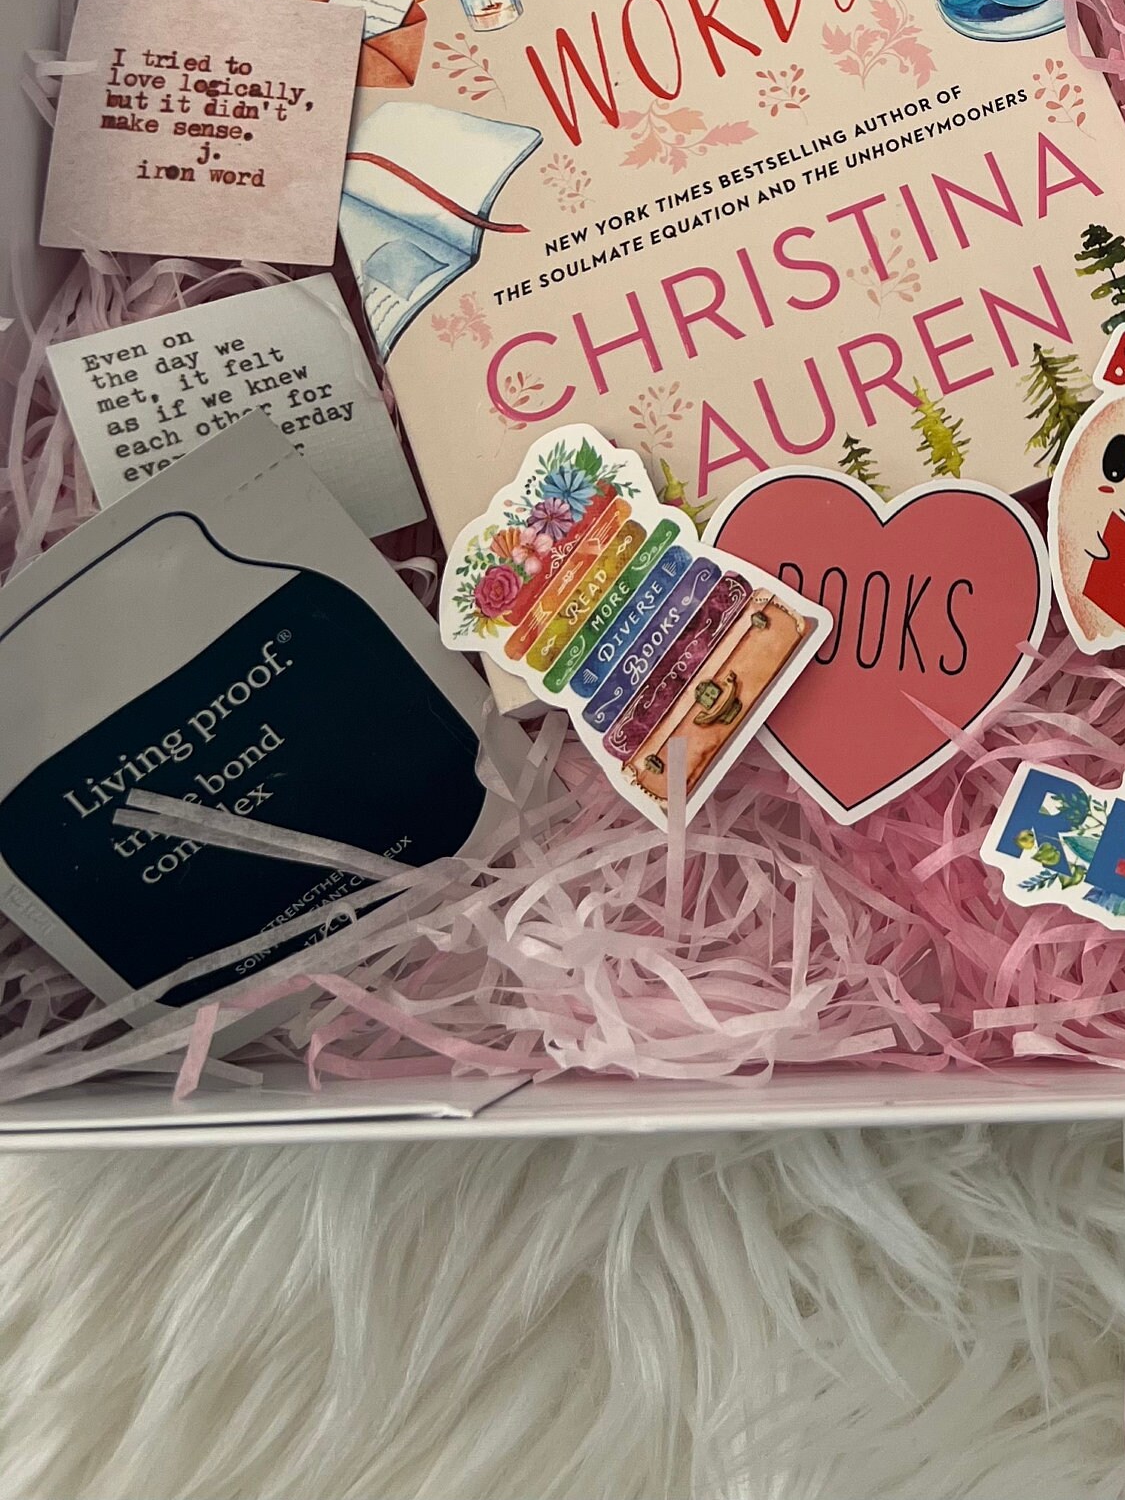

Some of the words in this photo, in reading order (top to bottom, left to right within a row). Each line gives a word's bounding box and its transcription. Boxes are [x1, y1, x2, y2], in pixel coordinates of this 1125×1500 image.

[107, 67, 166, 90] love
[179, 73, 314, 113] logically,
[112, 48, 126, 67] I
[142, 49, 211, 73] tried
[225, 59, 252, 75] to
[100, 114, 159, 134] make
[173, 122, 254, 142] sense.
[105, 90, 149, 110] but
[160, 93, 191, 113] it
[204, 99, 288, 122] didn't
[136, 160, 196, 182] iron
[209, 169, 265, 188] word
[197, 141, 220, 165] j.
[545, 227, 588, 257] NEW
[596, 204, 650, 236] YORK
[655, 180, 713, 213] TIMES
[718, 129, 848, 190] BESTSELLING
[854, 98, 932, 138] AUTHOR
[936, 85, 962, 105] OF
[494, 279, 533, 305] THE
[539, 235, 644, 288] SOULMATE
[650, 195, 750, 245] EQUATION
[757, 178, 797, 205] AND
[802, 160, 840, 185] THE
[845, 89, 1028, 169] UNHONEYMOONERS
[486, 131, 1105, 422] CHRISTINA
[81, 343, 149, 373] Even
[163, 331, 195, 349] on
[91, 369, 140, 390] the
[155, 351, 200, 375] day
[214, 337, 245, 357] we
[97, 389, 160, 414] met,
[179, 370, 210, 392] it
[224, 347, 285, 377] felt
[609, 265, 1072, 506] AUREN
[107, 417, 140, 437] as
[157, 401, 188, 424] if
[201, 390, 233, 410] we
[248, 365, 309, 396] knew
[115, 432, 183, 459] each
[287, 383, 332, 409] for
[565, 570, 607, 625] READ
[591, 582, 630, 631] MORE
[598, 581, 663, 662] DIVERSE
[623, 607, 680, 685] BOOKS
[63, 728, 194, 818] Living
[194, 724, 285, 795] bond
